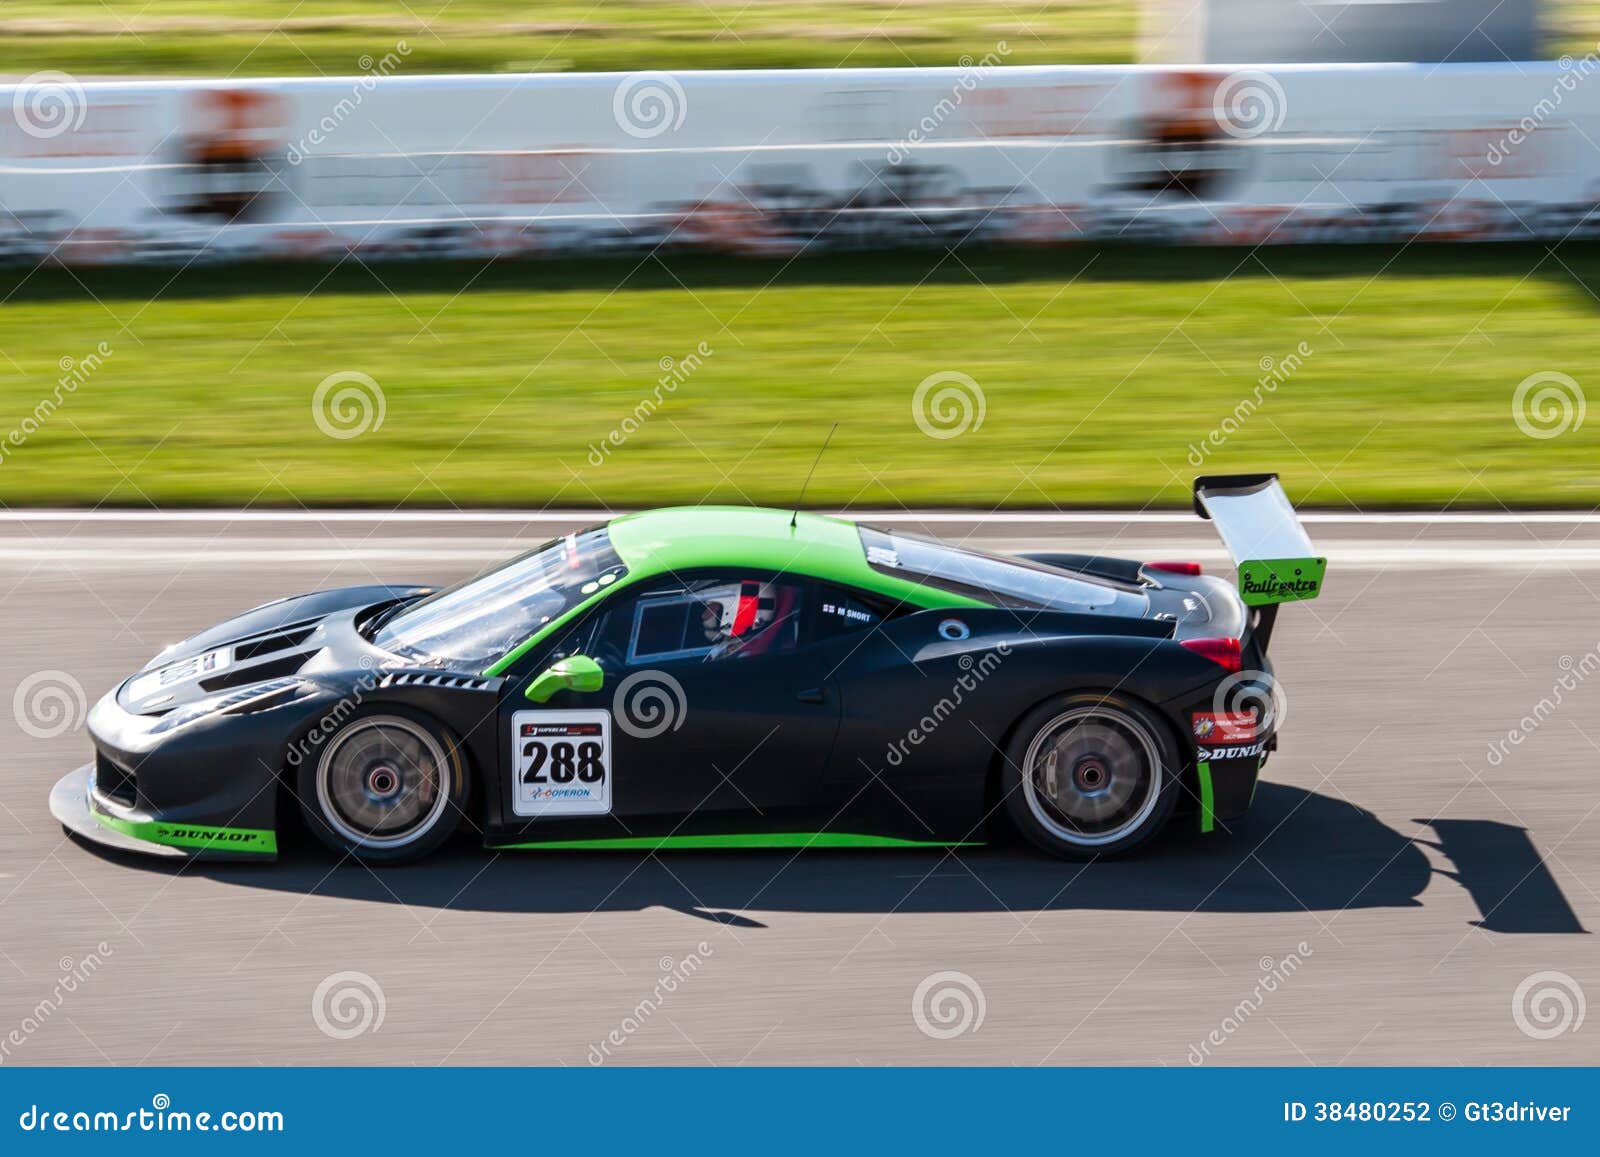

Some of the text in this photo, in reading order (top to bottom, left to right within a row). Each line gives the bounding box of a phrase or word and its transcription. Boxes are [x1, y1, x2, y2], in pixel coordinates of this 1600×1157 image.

[838, 607, 871, 622] M SHORT
[523, 741, 603, 784] 288
[172, 829, 258, 842] DUNLOP
